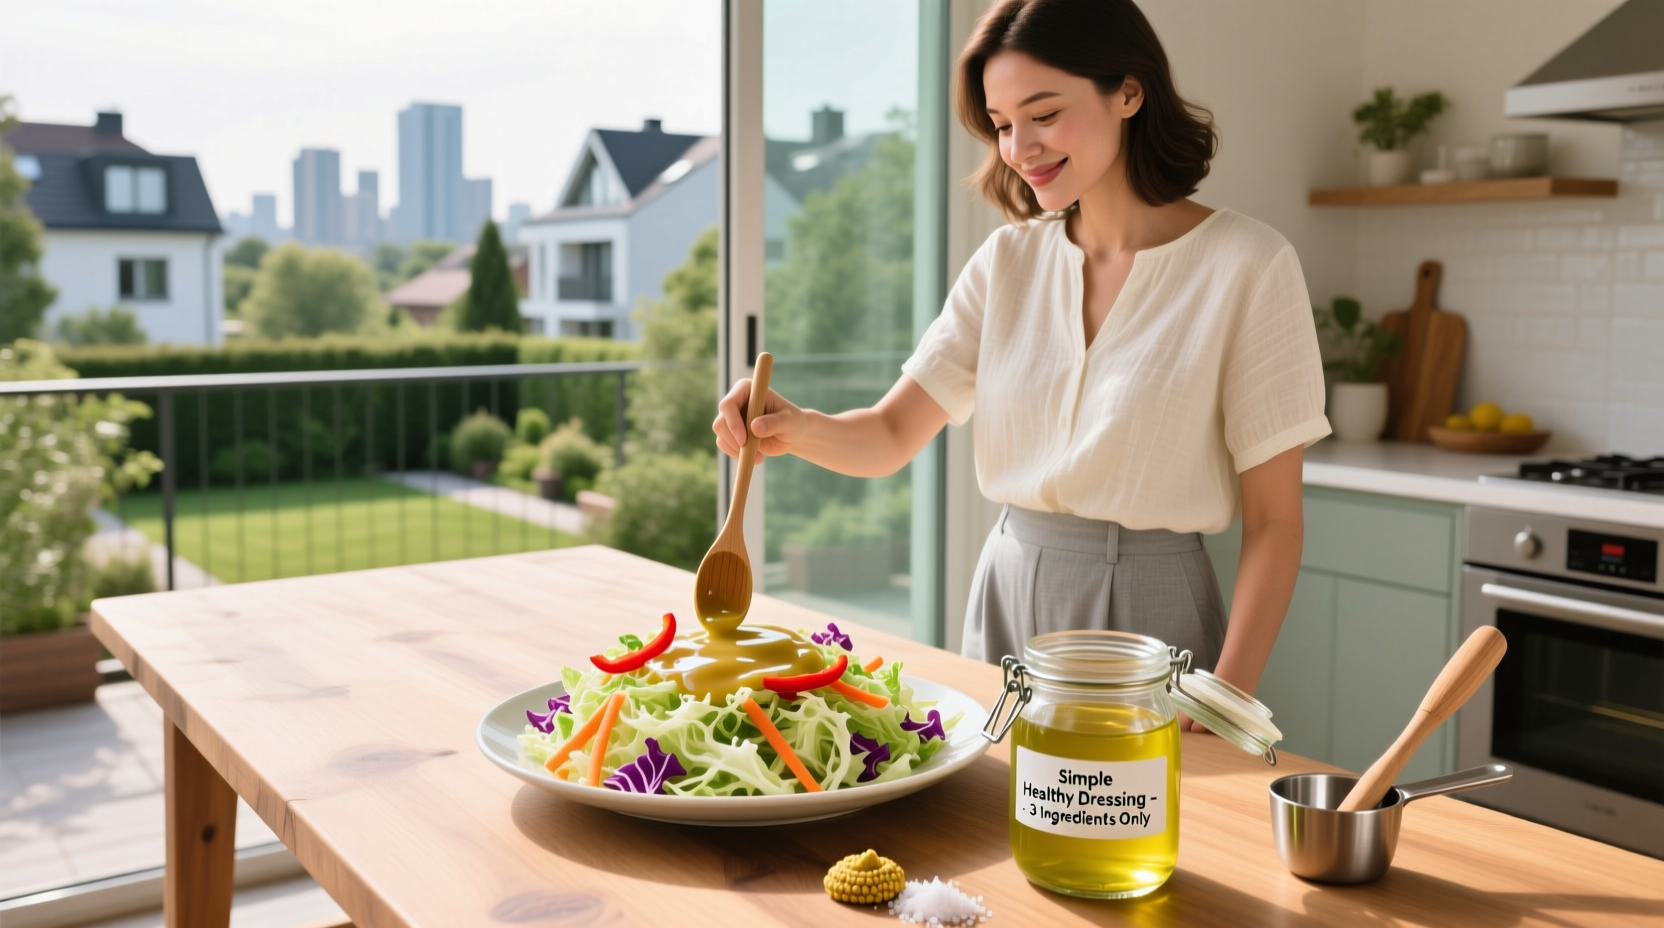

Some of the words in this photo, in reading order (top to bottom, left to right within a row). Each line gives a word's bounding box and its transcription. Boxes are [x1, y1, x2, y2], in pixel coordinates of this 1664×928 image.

[1058, 769, 1113, 791] Simple
[1023, 781, 1074, 808] Healthy
[1078, 791, 1146, 809] Dressing
[1029, 803, 1037, 816] 3
[1040, 806, 1116, 826] Ingredients
[1119, 811, 1151, 827] Only
